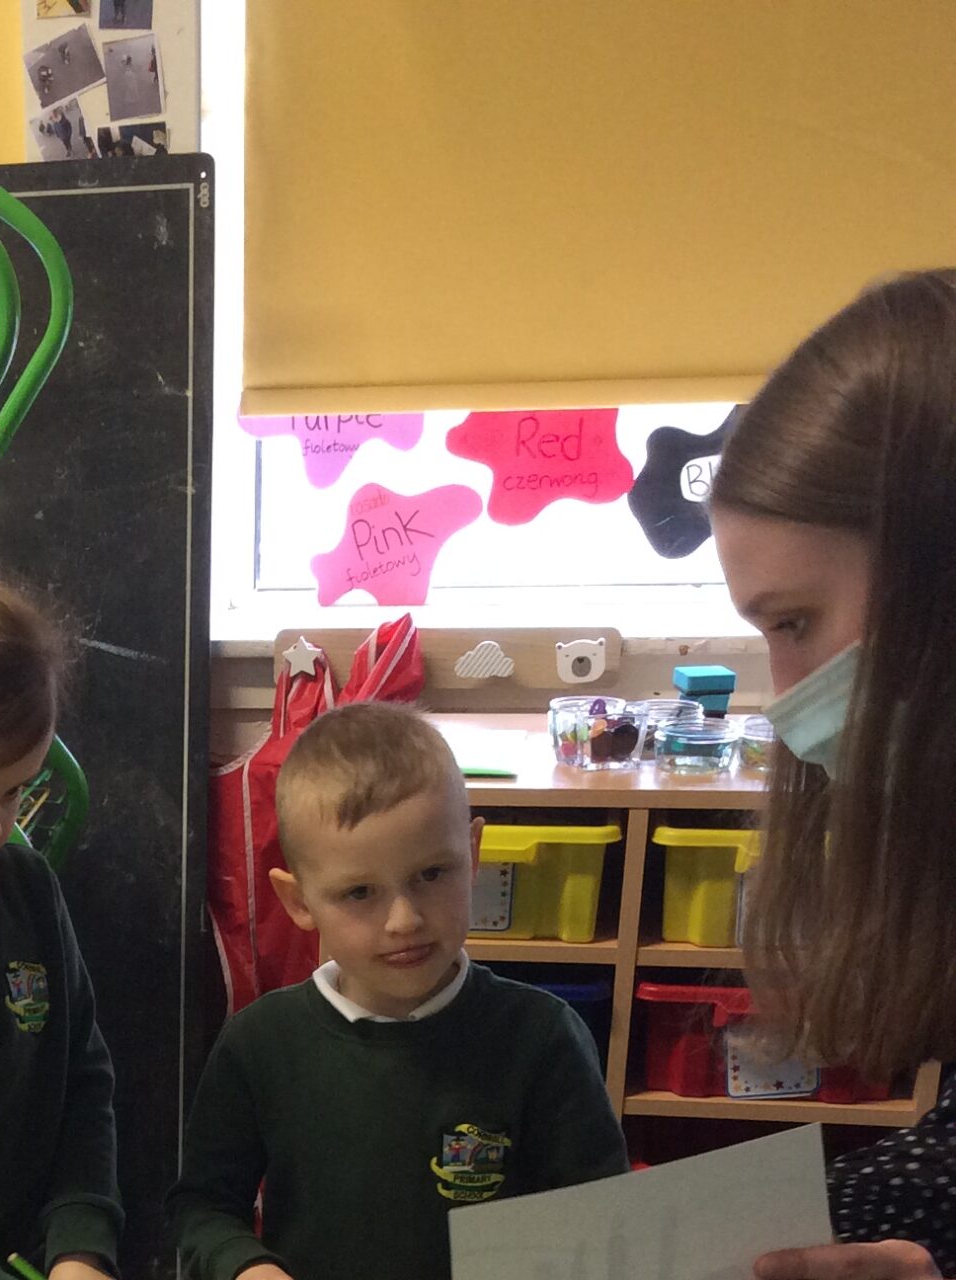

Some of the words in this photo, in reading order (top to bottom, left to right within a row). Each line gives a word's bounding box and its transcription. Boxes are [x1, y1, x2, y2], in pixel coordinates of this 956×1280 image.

[515, 416, 584, 461] Red
[686, 461, 714, 497] Bl
[346, 552, 422, 592] fioletowy
